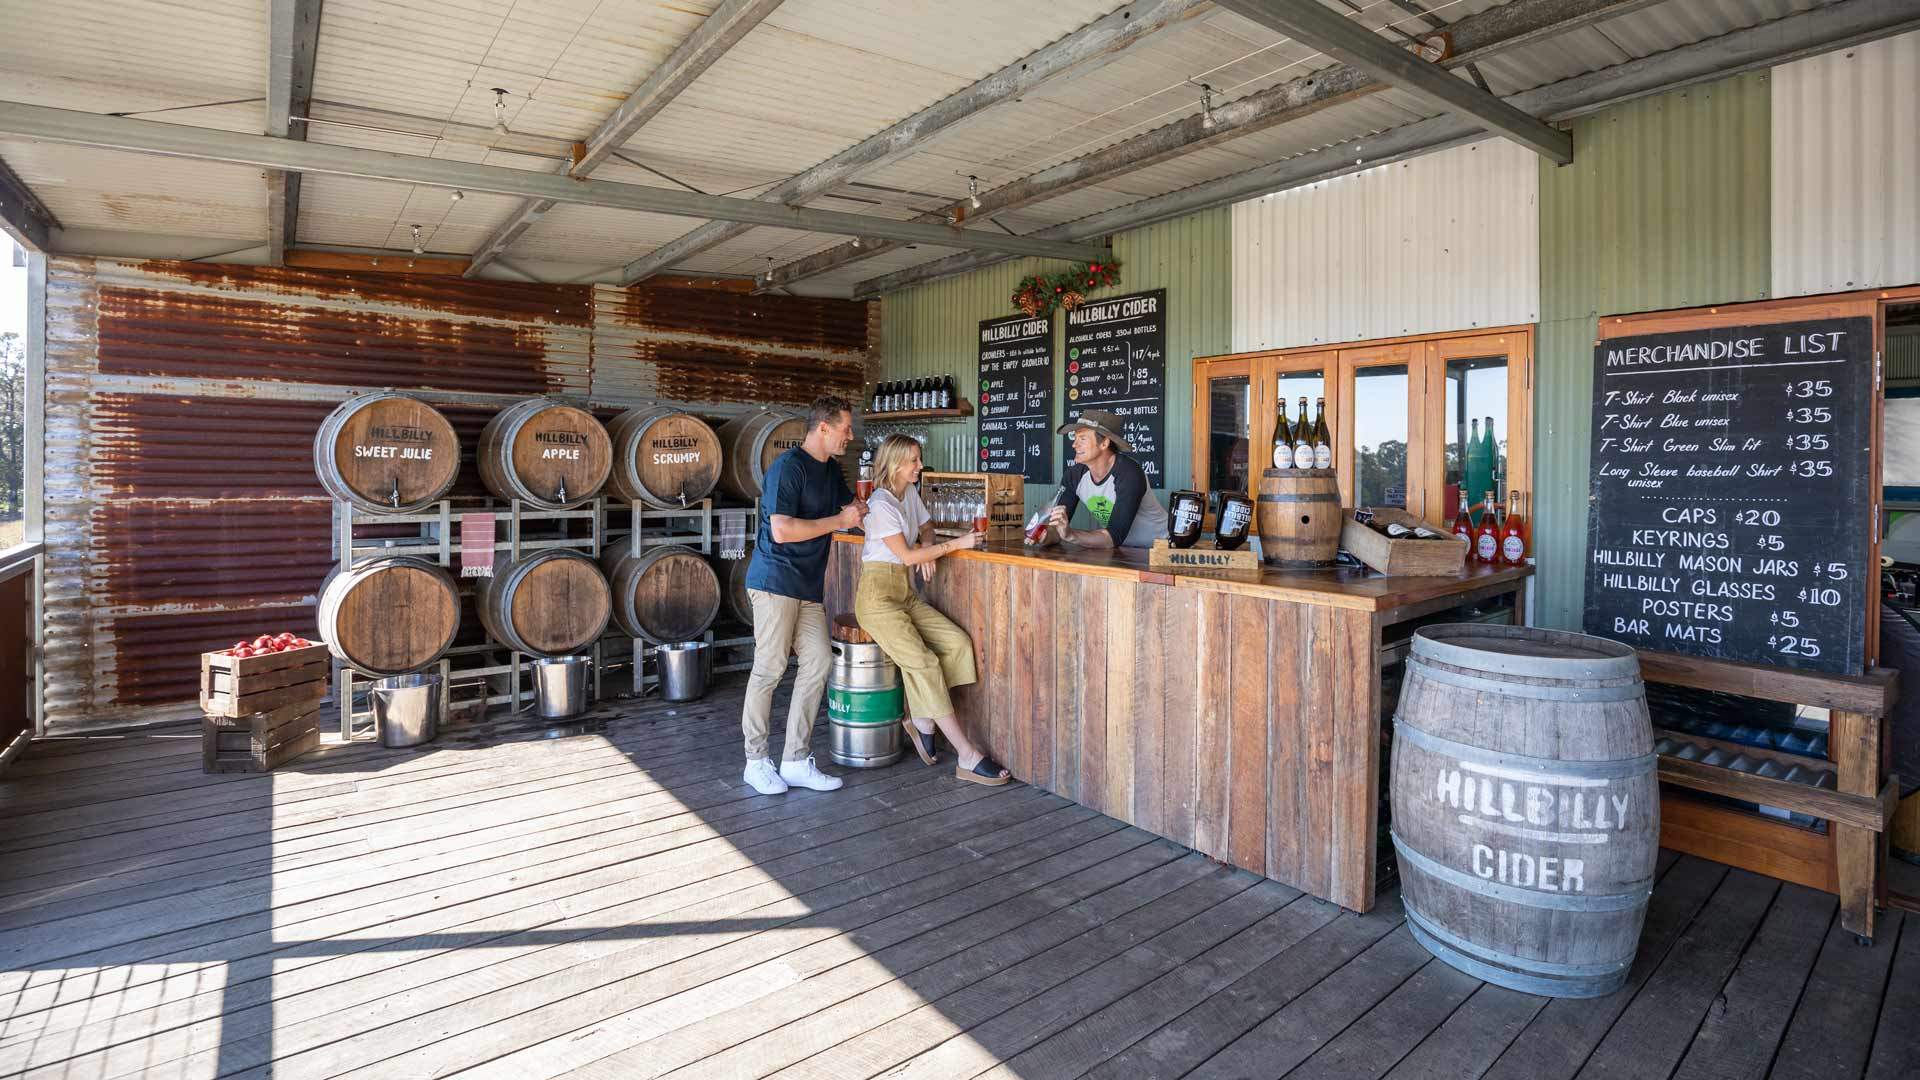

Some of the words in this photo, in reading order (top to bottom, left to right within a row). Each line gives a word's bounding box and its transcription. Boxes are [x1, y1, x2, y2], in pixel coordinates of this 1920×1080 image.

[1070, 304, 1120, 324] HILLBILLY
[1123, 298, 1156, 316] CIDER
[982, 324, 1020, 342] HILLBILLY
[1022, 320, 1048, 336] CIDER
[1070, 334, 1094, 343] ALCOHOLIC
[1096, 331, 1112, 340] CIDERS
[1134, 325, 1156, 334] BOTTLES
[1607, 338, 1765, 366] MERCHANDISE
[1784, 332, 1847, 355] LIST
[992, 362, 1000, 370] THE
[1003, 360, 1018, 370] EMPTY
[991, 380, 1004, 388] APPLE
[1785, 380, 1833, 398] $35
[990, 393, 1004, 402] SWEET
[1604, 391, 1654, 406] T-Shirt
[1663, 390, 1697, 404] Black
[1702, 392, 1739, 402] unisex
[1134, 406, 1158, 414] BOTTLES
[1786, 407, 1832, 423] $35
[1601, 414, 1653, 430] T-Shirt
[1660, 413, 1689, 428] Blue
[1695, 416, 1730, 427] unisex
[369, 426, 433, 441] HILLBILLY
[535, 431, 588, 444] HILLBILLY
[652, 438, 698, 448] HILLBILLY
[1600, 438, 1654, 453] T-Shirt
[1663, 438, 1699, 452] Green
[1709, 437, 1735, 451] Slim
[1786, 434, 1829, 451] $35
[355, 445, 398, 458] SWEET
[400, 447, 433, 460] JULIE
[542, 448, 580, 460] APPLE
[653, 452, 700, 464] SCRUMPY
[1600, 462, 1630, 479] Long
[1639, 462, 1679, 477] Sleeve
[1686, 464, 1740, 477] baseball
[1746, 463, 1783, 477] Shirt
[1789, 460, 1833, 478] $35
[1628, 478, 1663, 489] unisex
[1662, 508, 1717, 525] CAPS
[1735, 510, 1781, 527] $20
[1632, 530, 1729, 549] KEYRINGS
[1756, 534, 1785, 551] $5
[1170, 553, 1231, 565] HILLBILLY
[1593, 550, 1665, 568] HILLBILLY
[1679, 555, 1742, 573] MASON
[1753, 559, 1799, 577] JARS
[1813, 562, 1848, 580] $5
[1604, 574, 1681, 593] HILLBILLY
[1692, 580, 1776, 601] GLASSES
[1797, 587, 1841, 606] $10
[1642, 598, 1733, 622] POSTERS
[1770, 610, 1799, 628] $5
[1614, 617, 1650, 636] BAR
[1665, 624, 1722, 644] MATS
[1767, 635, 1820, 657] $25
[1437, 768, 1629, 831] HILLBILLY
[1472, 844, 1585, 892] CIDER
